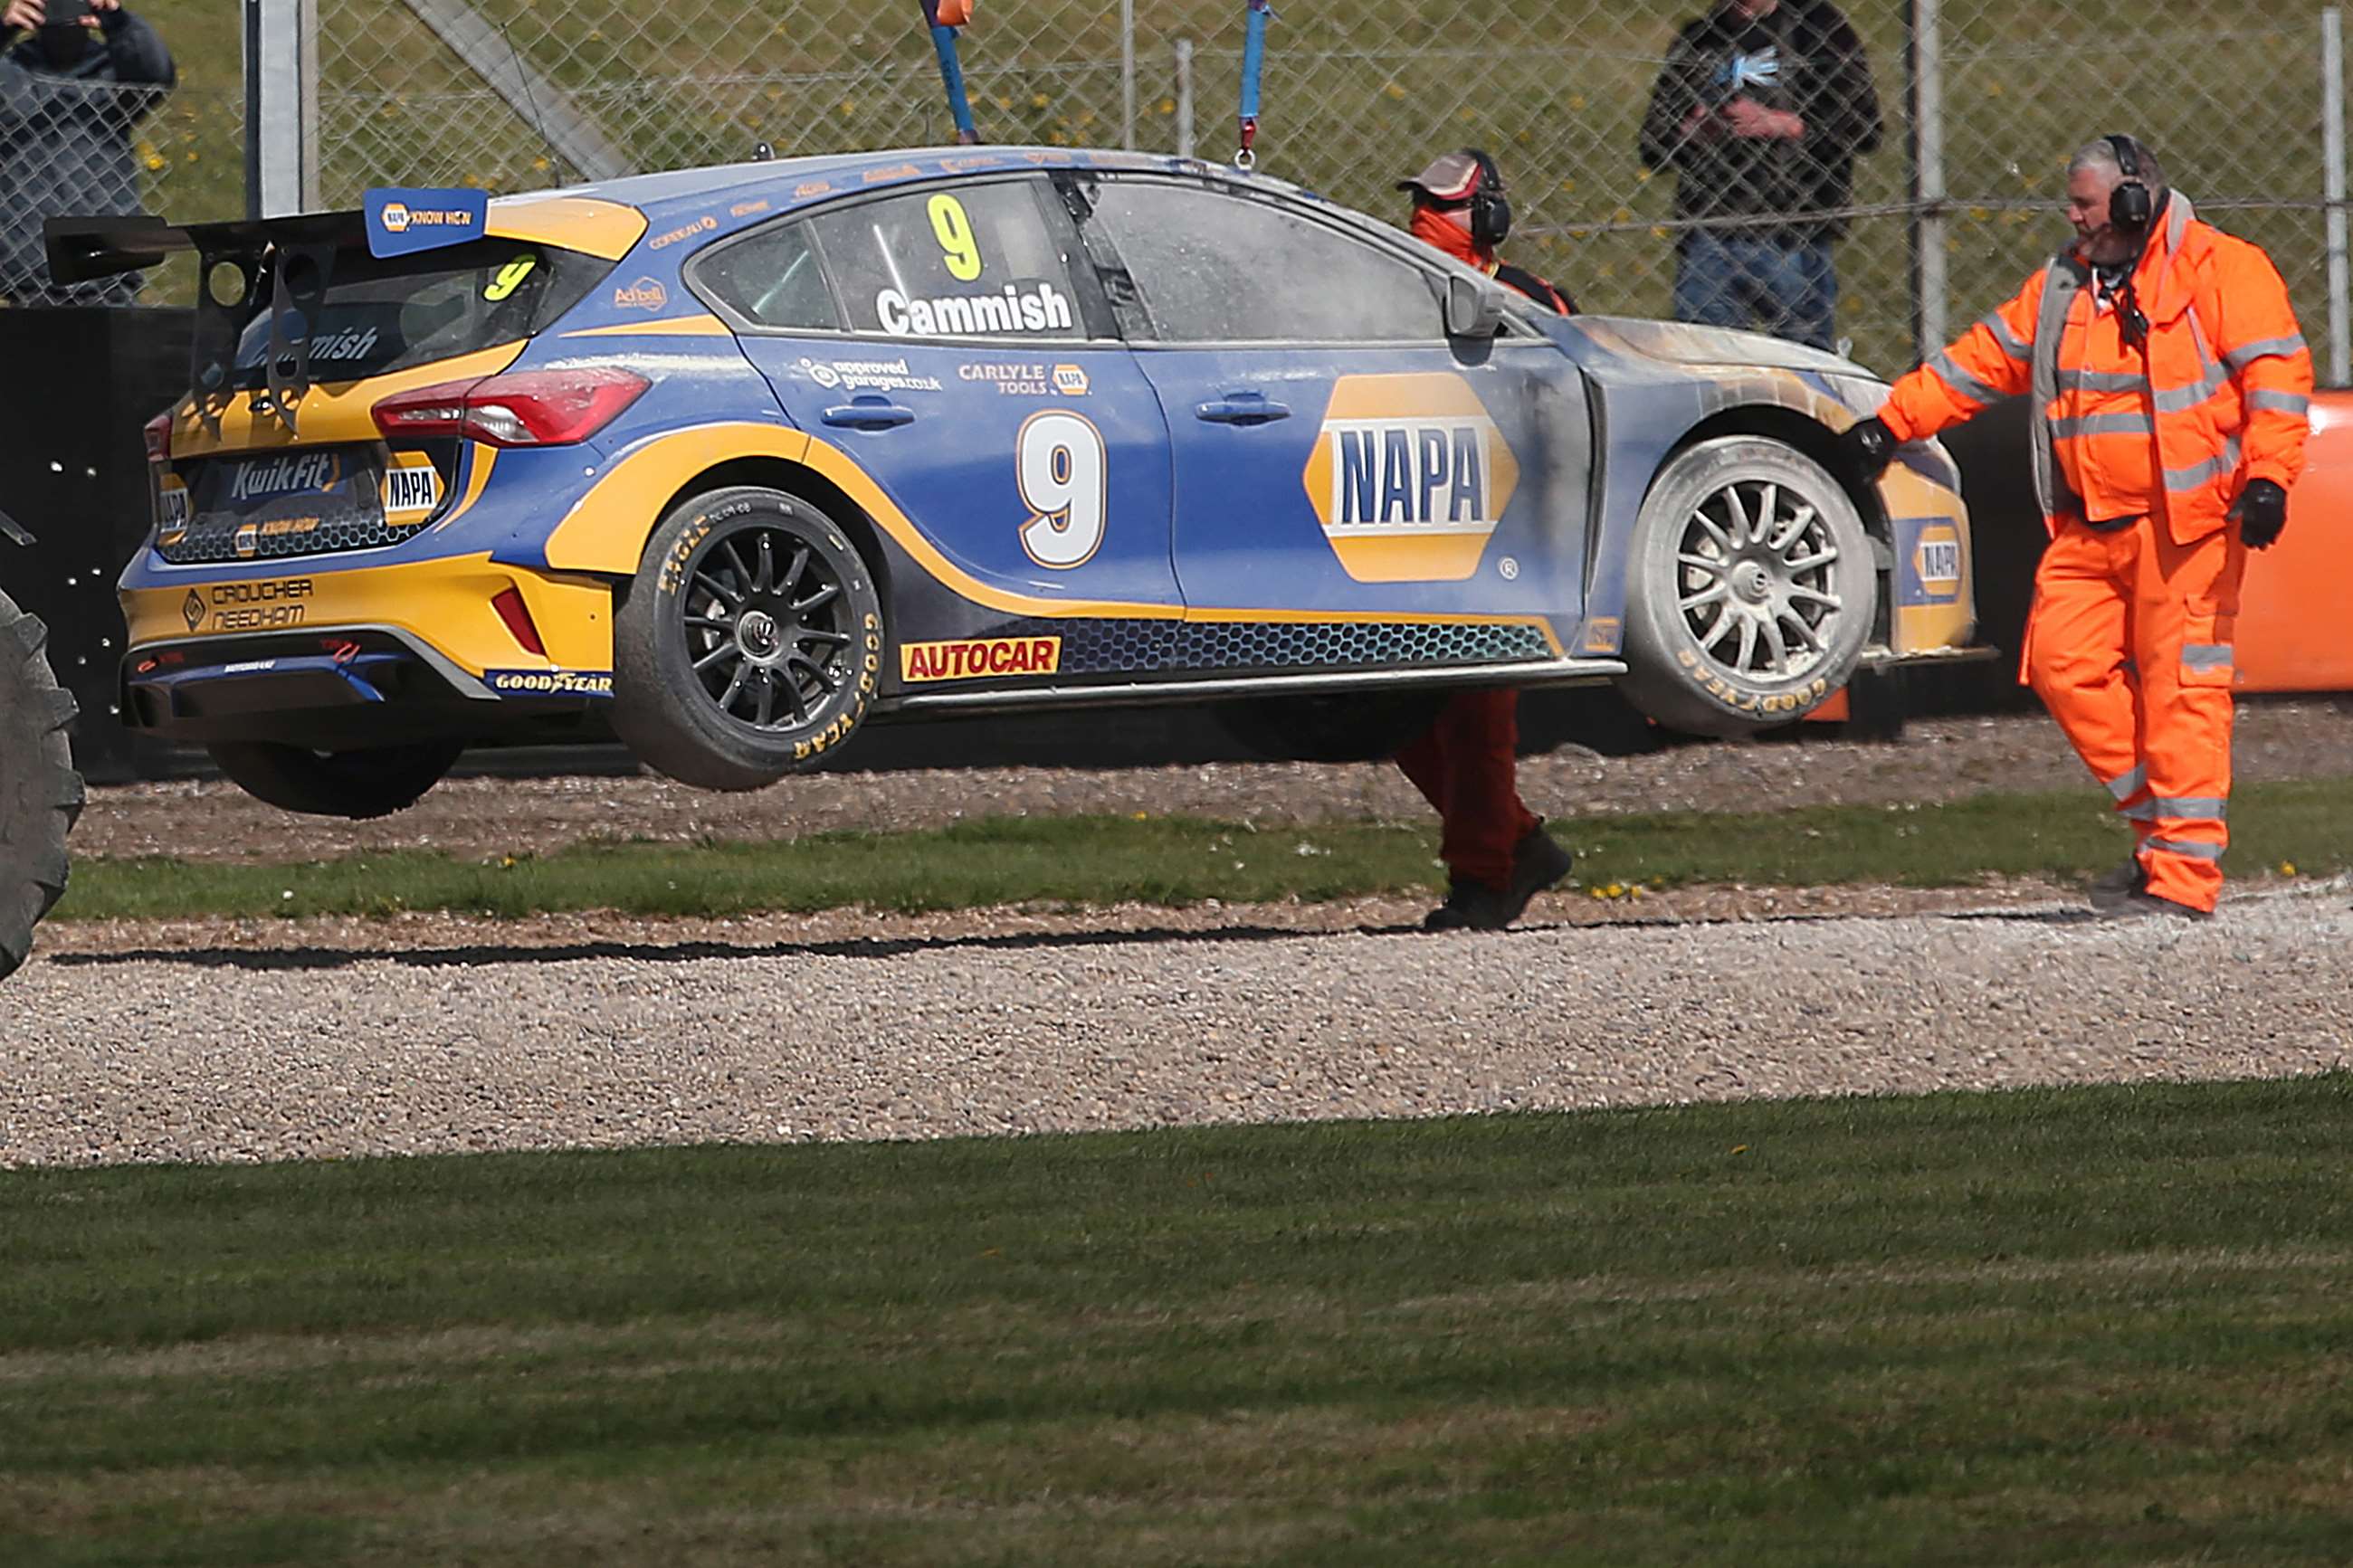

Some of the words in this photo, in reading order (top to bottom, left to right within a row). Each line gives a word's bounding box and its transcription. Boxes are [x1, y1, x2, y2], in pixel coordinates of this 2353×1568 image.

[928, 194, 983, 281] 9
[483, 252, 538, 302] 9
[875, 282, 1072, 335] Cammish
[832, 357, 910, 375] approved
[958, 364, 1045, 381] CARLYLE
[996, 381, 1048, 395] TOOLS
[389, 470, 433, 507] NAPA
[1016, 409, 1108, 570] 9
[1340, 427, 1484, 525] NAPA
[211, 578, 314, 605] CROUCHER
[211, 603, 304, 631] NEEDHAM
[907, 640, 1055, 679] AUTOCAR
[495, 672, 614, 694] GOODYEAR
[794, 613, 881, 760] GOODYEAR
[1677, 649, 1827, 712] GOODYEAR
